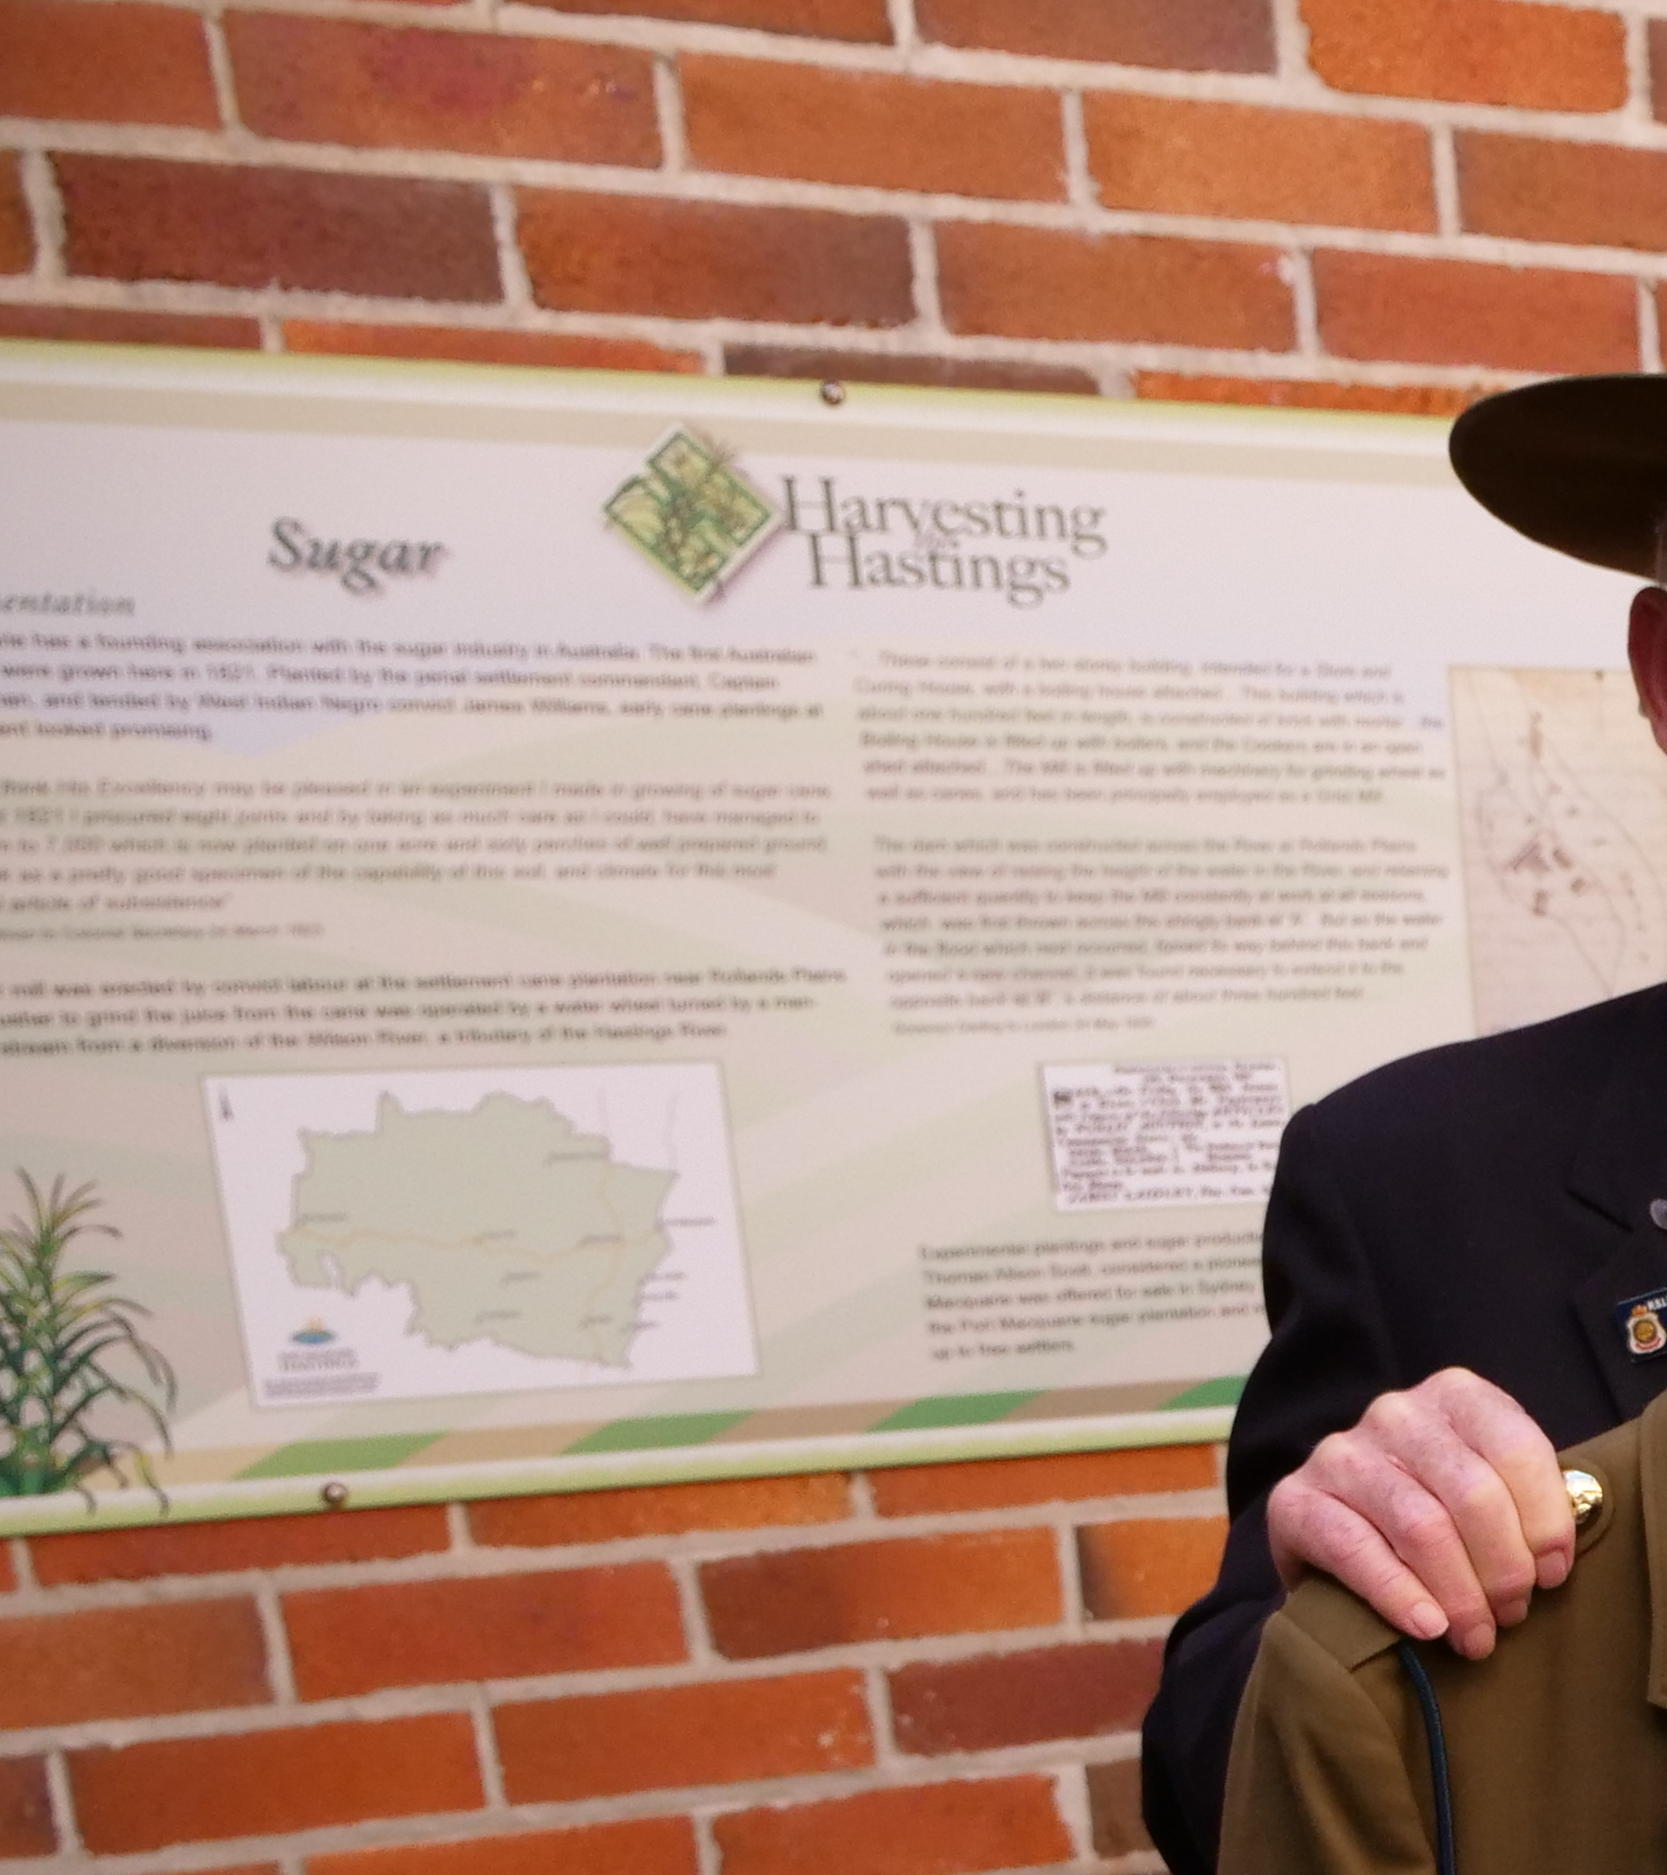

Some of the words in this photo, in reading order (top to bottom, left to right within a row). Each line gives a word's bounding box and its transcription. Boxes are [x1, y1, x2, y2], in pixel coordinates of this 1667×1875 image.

[267, 515, 446, 595] Sugar
[780, 475, 1108, 559] Harvesting
[808, 531, 1071, 609] Hastings
